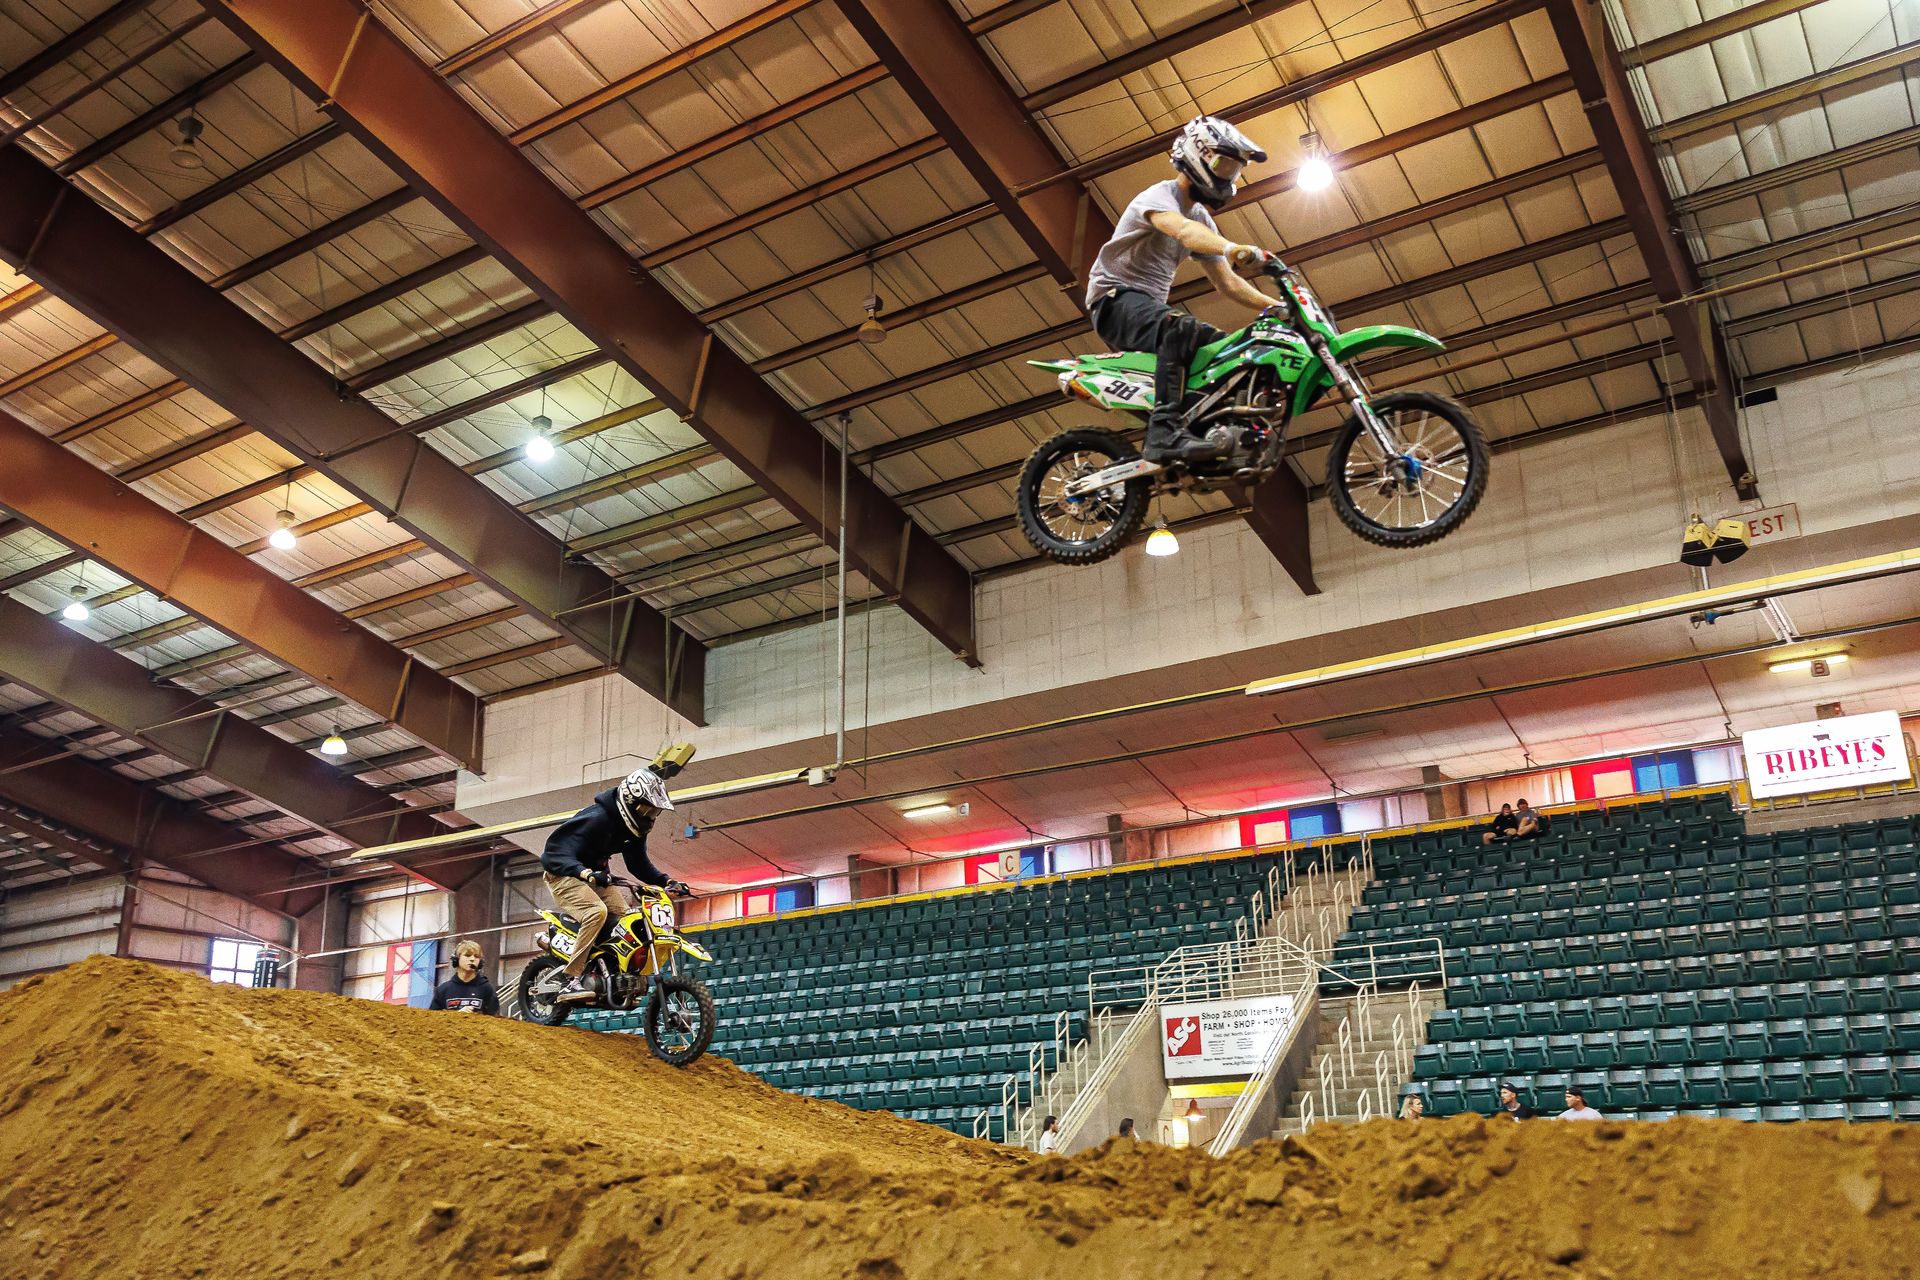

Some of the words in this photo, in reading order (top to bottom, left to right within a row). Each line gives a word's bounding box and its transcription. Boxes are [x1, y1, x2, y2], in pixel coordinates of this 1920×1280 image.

[1104, 380, 1140, 401] 98
[1748, 514, 1784, 538] EST
[1813, 662, 1825, 675] B
[1765, 738, 1886, 775] RIBEYES
[1005, 855, 1014, 873] C
[651, 903, 675, 927] 63
[1201, 1012, 1220, 1020] Shop
[1251, 1008, 1272, 1016] Items
[1275, 1006, 1288, 1014] For
[1203, 1022, 1225, 1031] FARM
[1234, 1020, 1256, 1028] SHOP
[1167, 1017, 1197, 1056] ASC
